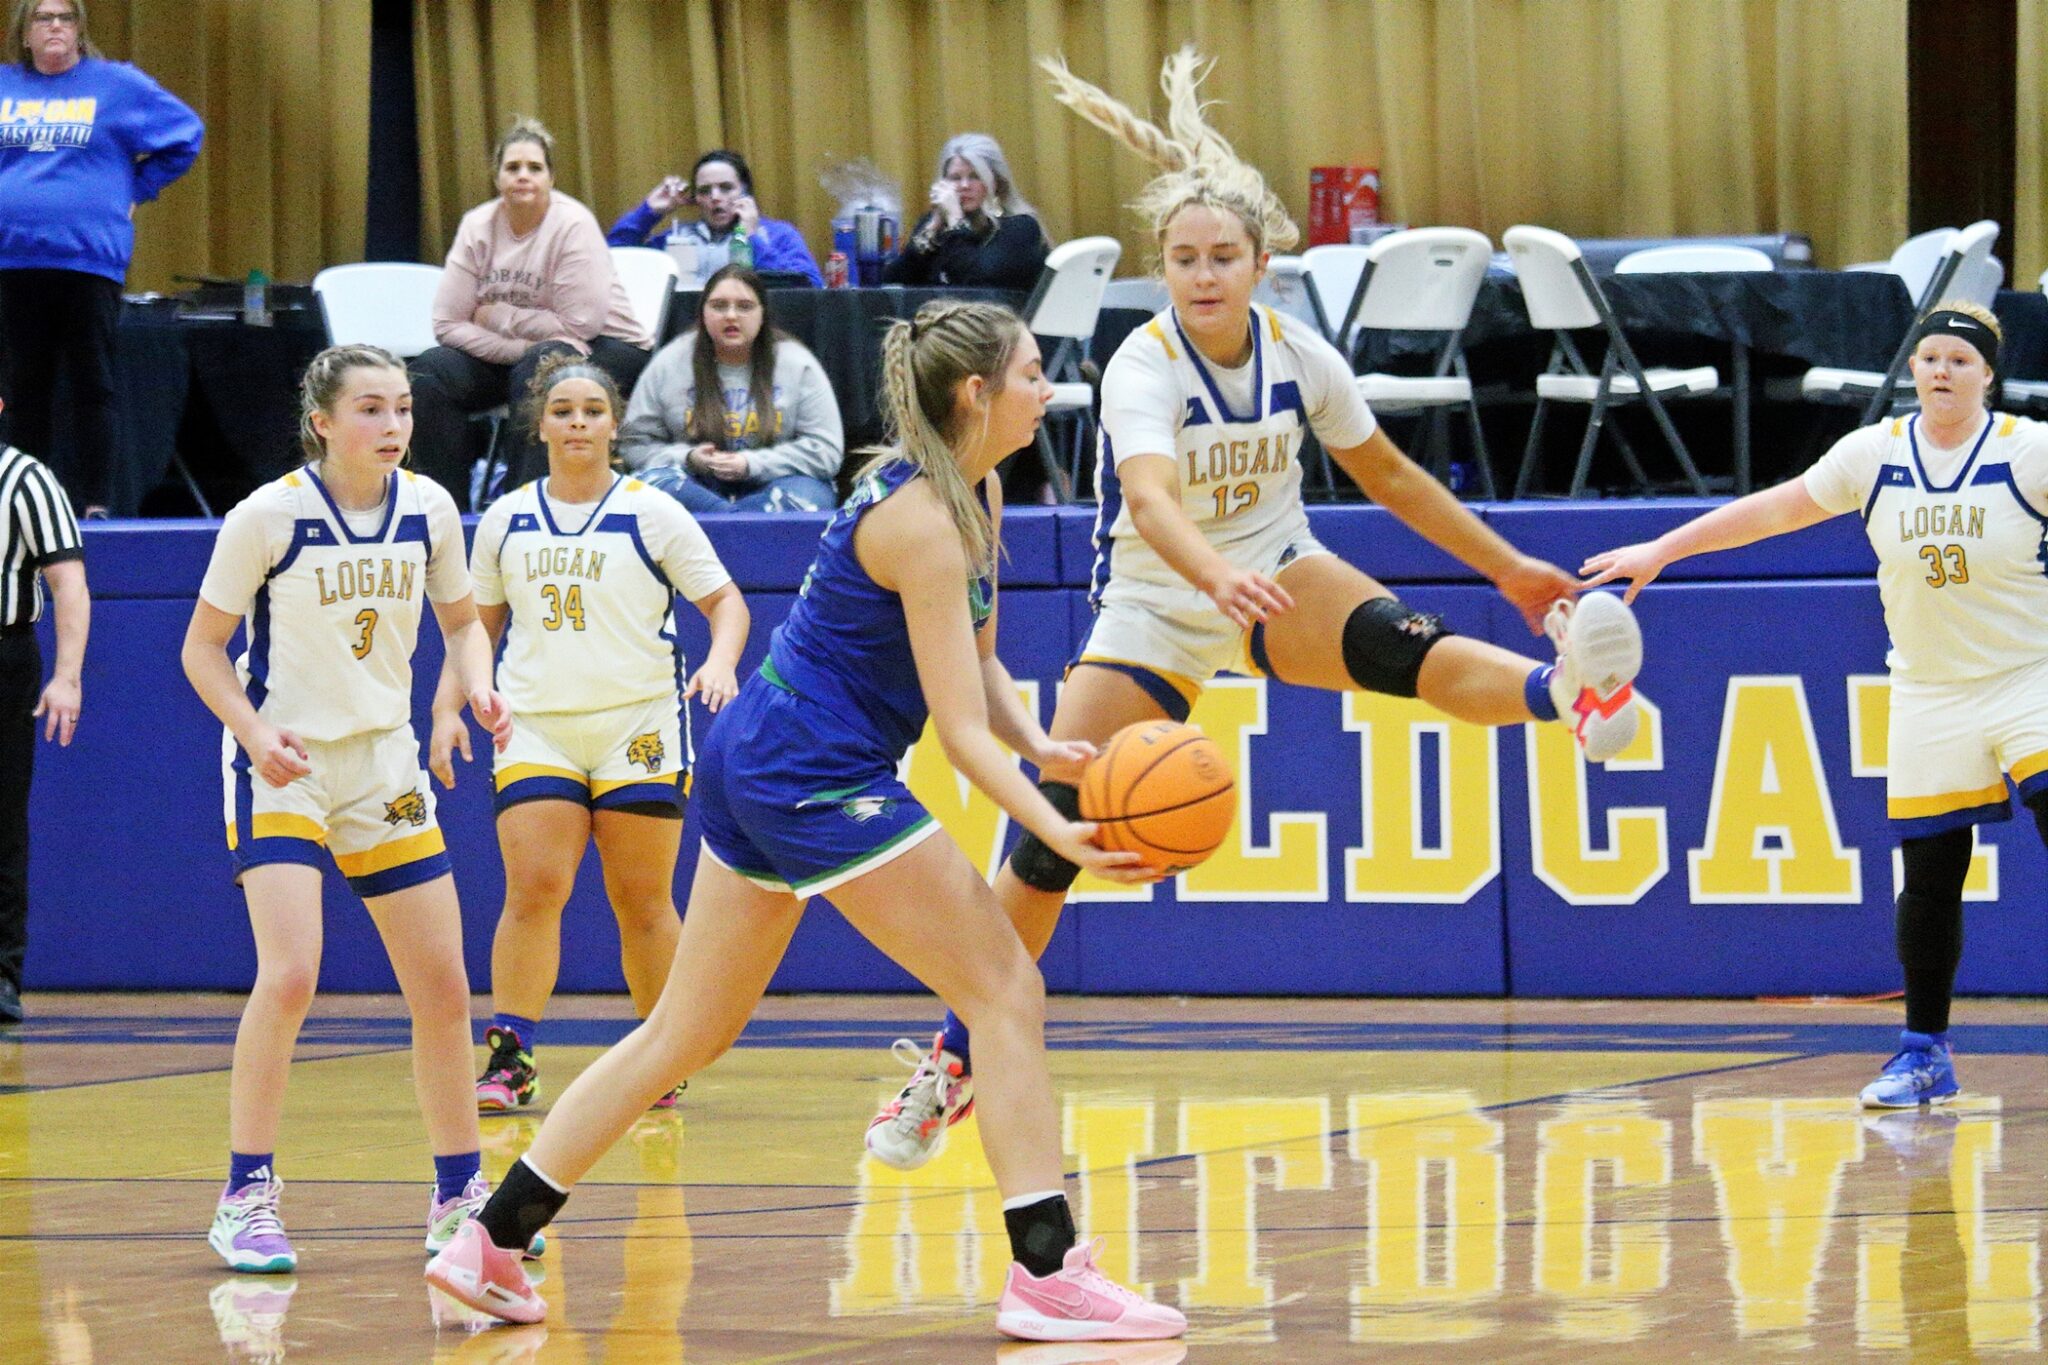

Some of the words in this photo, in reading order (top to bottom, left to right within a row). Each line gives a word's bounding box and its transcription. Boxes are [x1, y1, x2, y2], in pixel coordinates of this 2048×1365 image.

[1187, 433, 1290, 486] LOGAN
[1212, 481, 1260, 519] 12
[1899, 504, 1986, 542] LOGAN
[315, 558, 417, 606] LOGAN
[524, 546, 607, 582] LOGAN
[1919, 544, 1970, 589] 33
[540, 584, 586, 631] 34
[351, 608, 379, 660] 3
[897, 673, 1999, 906] LDCA
